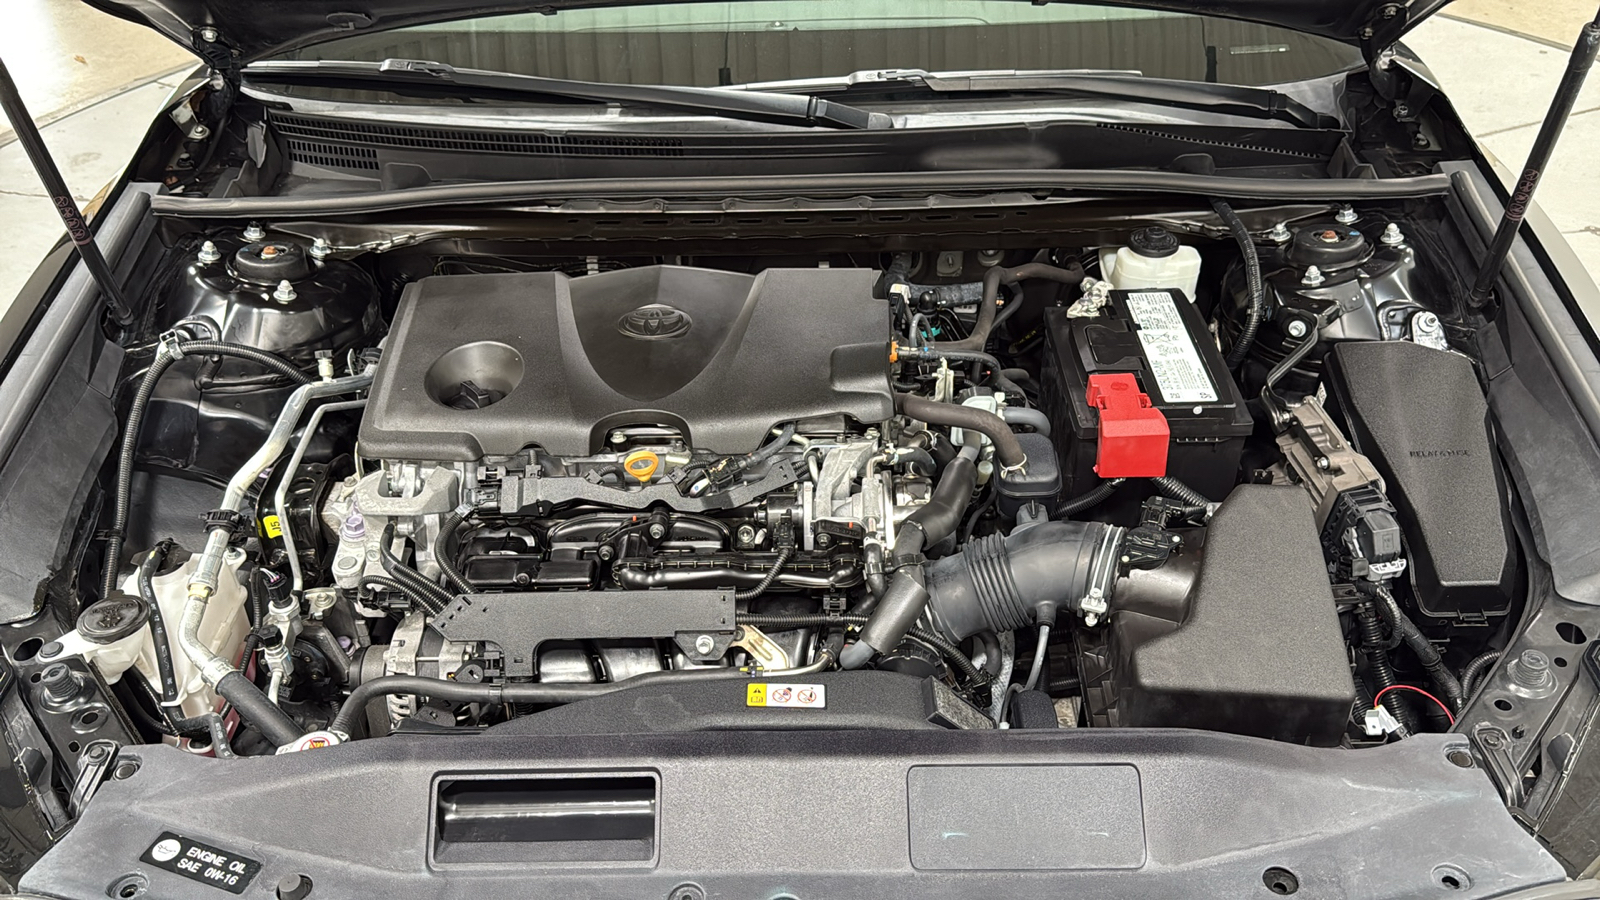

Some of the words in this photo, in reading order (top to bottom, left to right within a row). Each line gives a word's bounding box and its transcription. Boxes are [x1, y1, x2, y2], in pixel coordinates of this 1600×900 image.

[270, 521, 282, 532] J5
[176, 858, 203, 873] SAE
[204, 867, 239, 886] 0W-16
[186, 846, 228, 867] ENGINE
[229, 861, 247, 875] OIL
